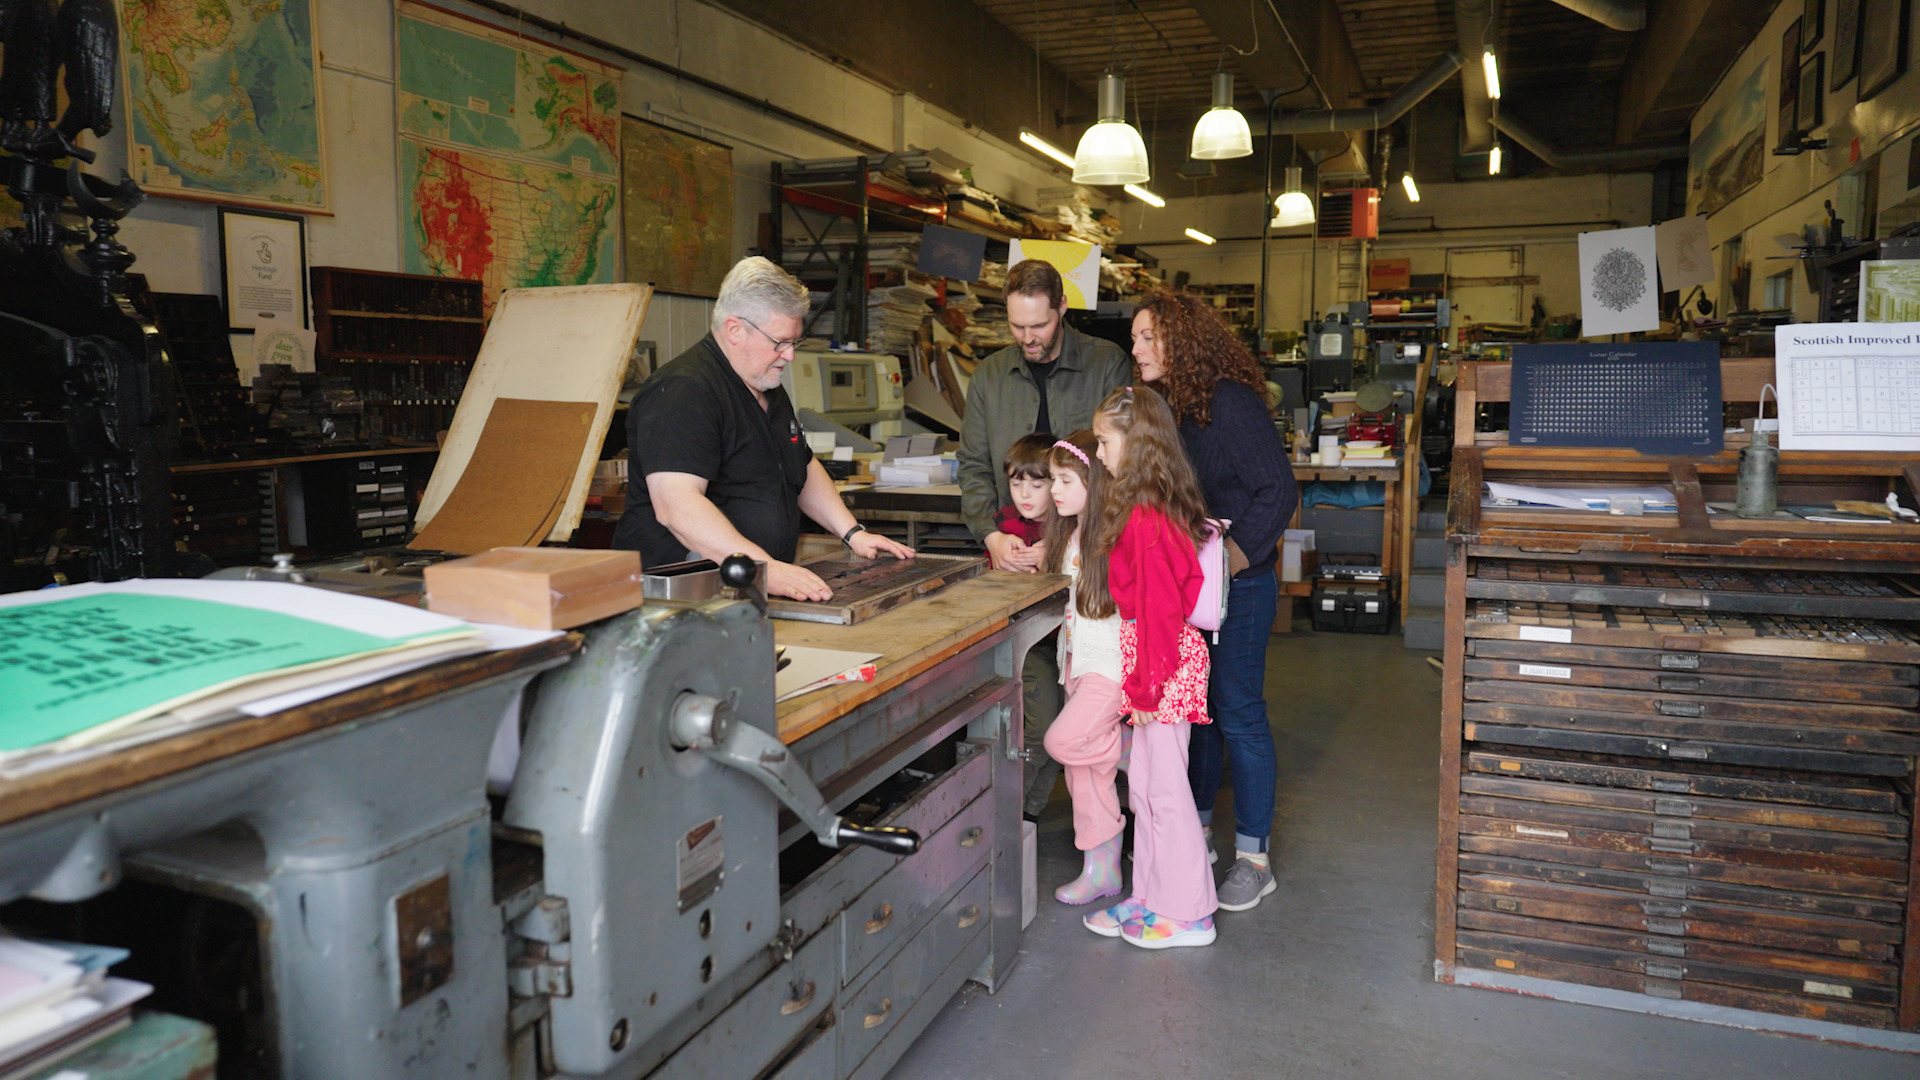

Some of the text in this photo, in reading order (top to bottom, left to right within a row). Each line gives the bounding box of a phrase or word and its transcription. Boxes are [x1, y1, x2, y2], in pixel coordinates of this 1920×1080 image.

[258, 272, 272, 280] Fund
[1793, 335, 1844, 346] Scottish
[1848, 335, 1911, 346] Improved
[98, 624, 195, 644] WILL
[26, 635, 209, 675] CONQUER
[49, 667, 124, 689] THE
[133, 637, 262, 666] WORLD
